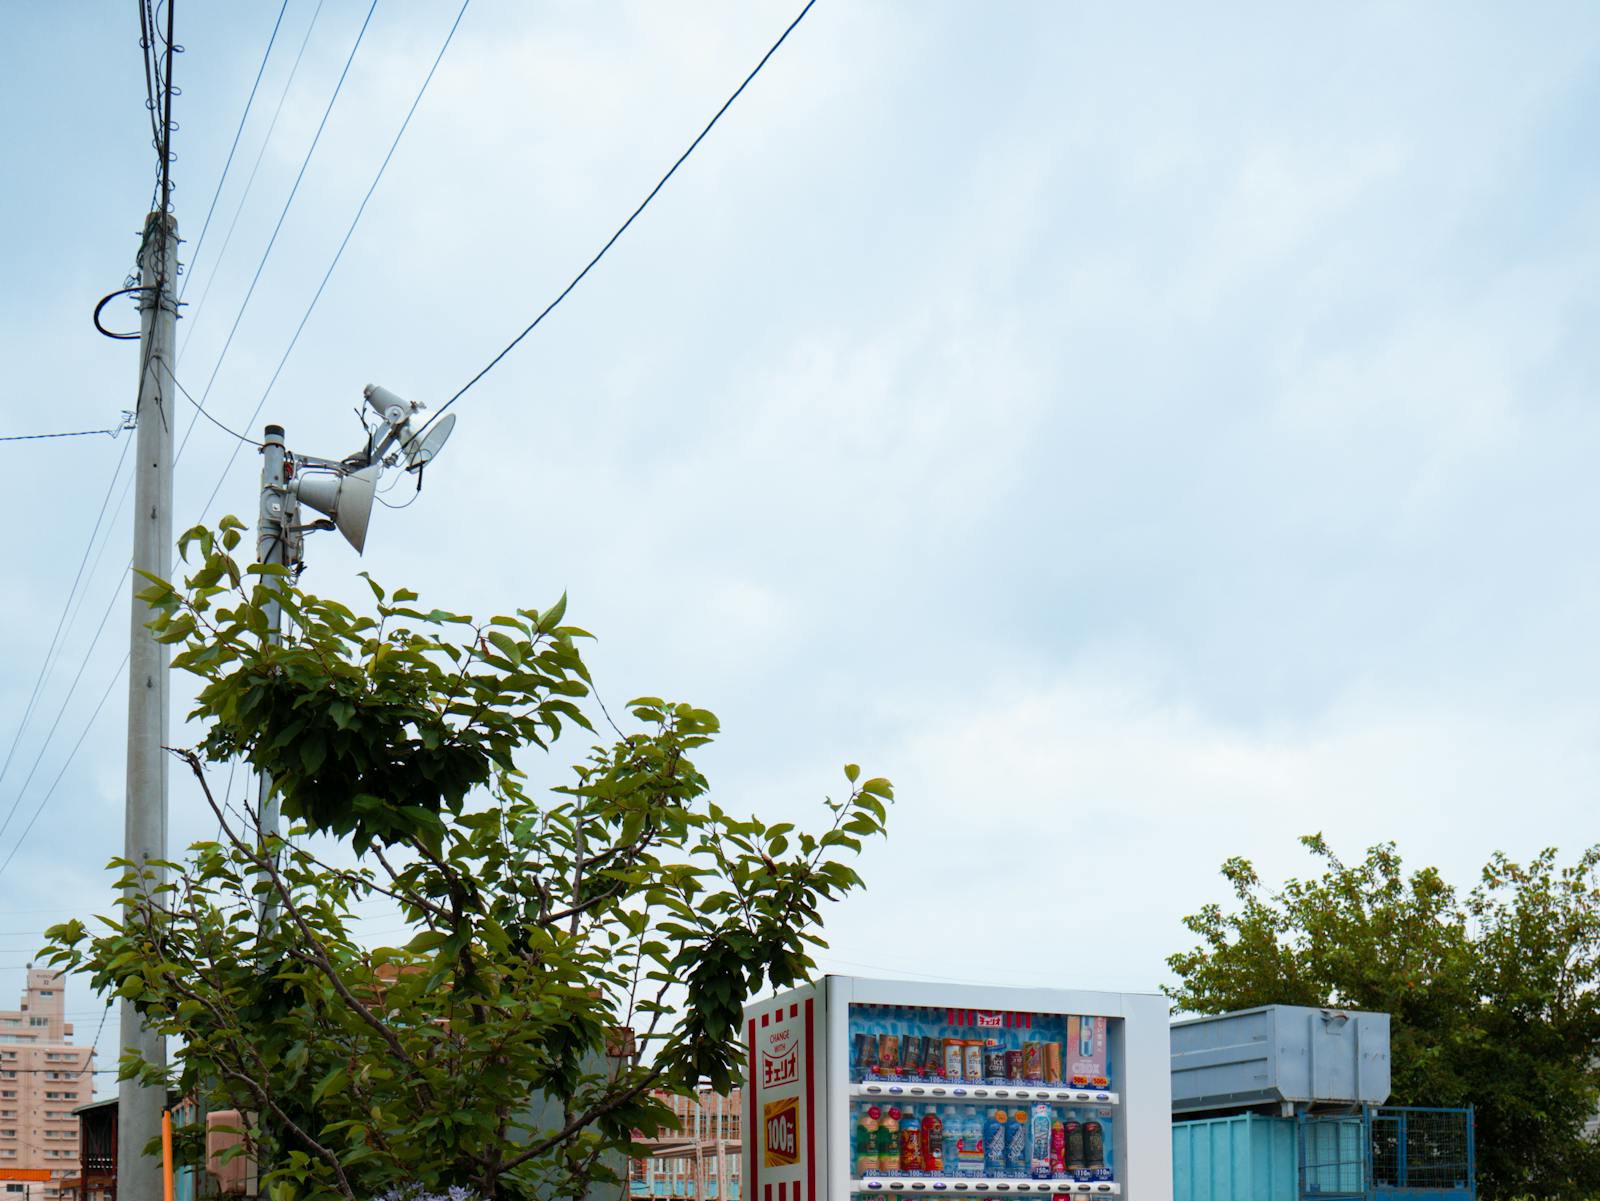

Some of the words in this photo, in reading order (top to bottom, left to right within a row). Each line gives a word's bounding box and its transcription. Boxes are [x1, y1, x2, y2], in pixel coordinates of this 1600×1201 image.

[979, 1016, 1000, 1026] チェリオ
[770, 1029, 790, 1044] CHANGE
[774, 1044, 786, 1052] WITH
[765, 1052, 796, 1084] チェリオ
